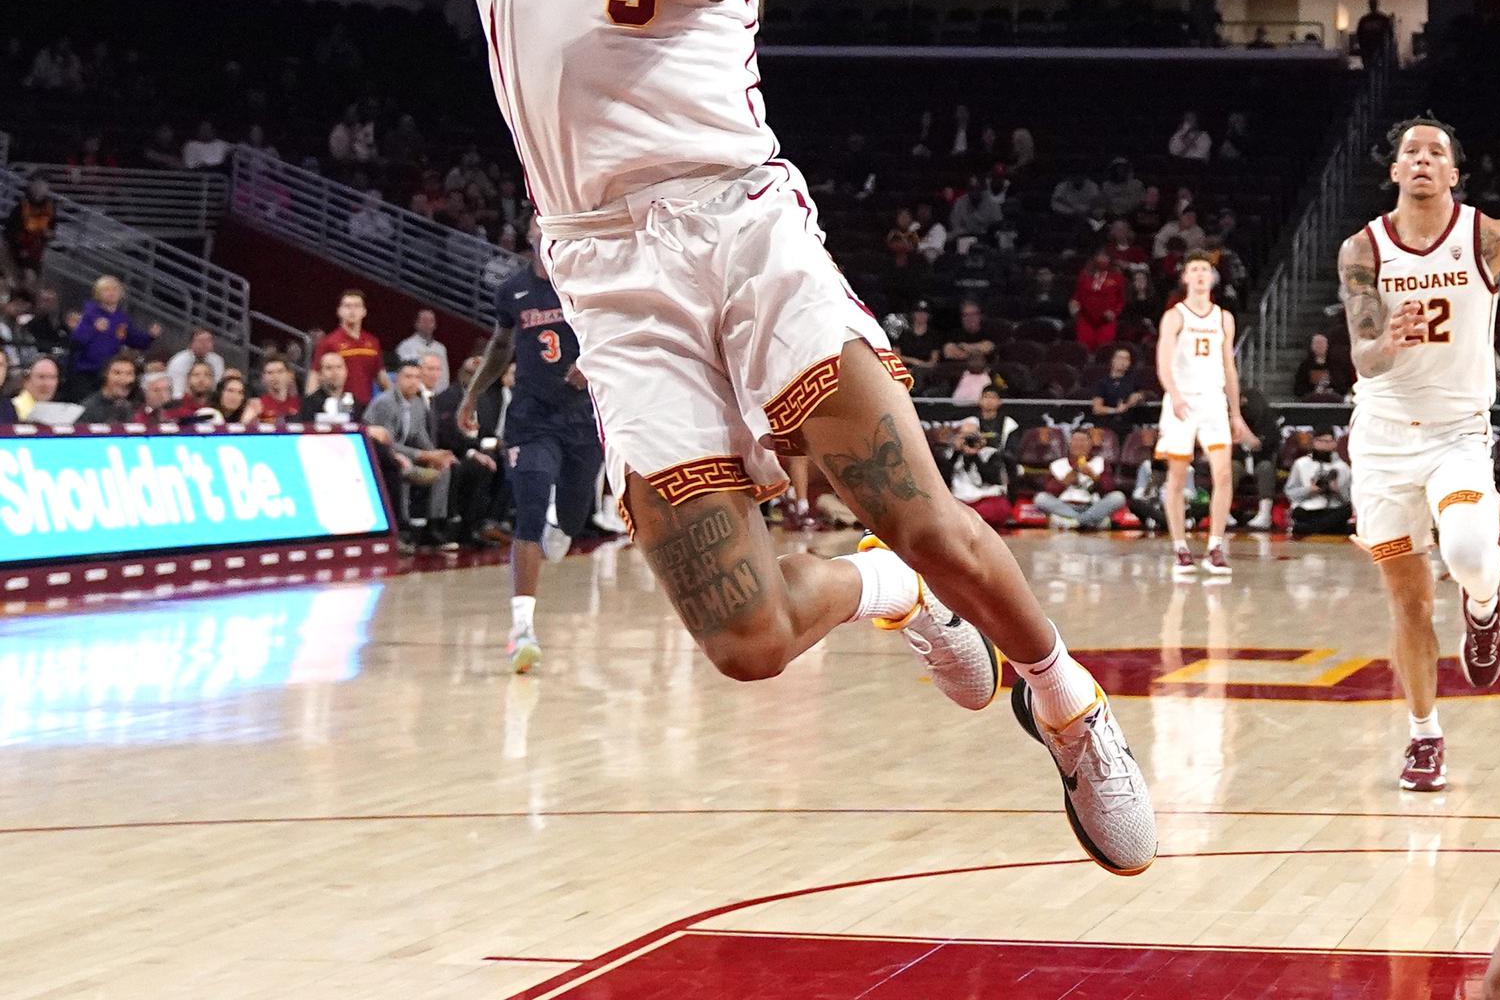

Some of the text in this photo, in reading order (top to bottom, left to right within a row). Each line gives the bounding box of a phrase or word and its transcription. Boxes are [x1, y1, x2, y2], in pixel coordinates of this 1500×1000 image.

[1381, 271, 1469, 293] TROJANS
[538, 329, 562, 363] 3
[1194, 338, 1211, 357] 13
[0, 445, 297, 535] Shouldn't Be.
